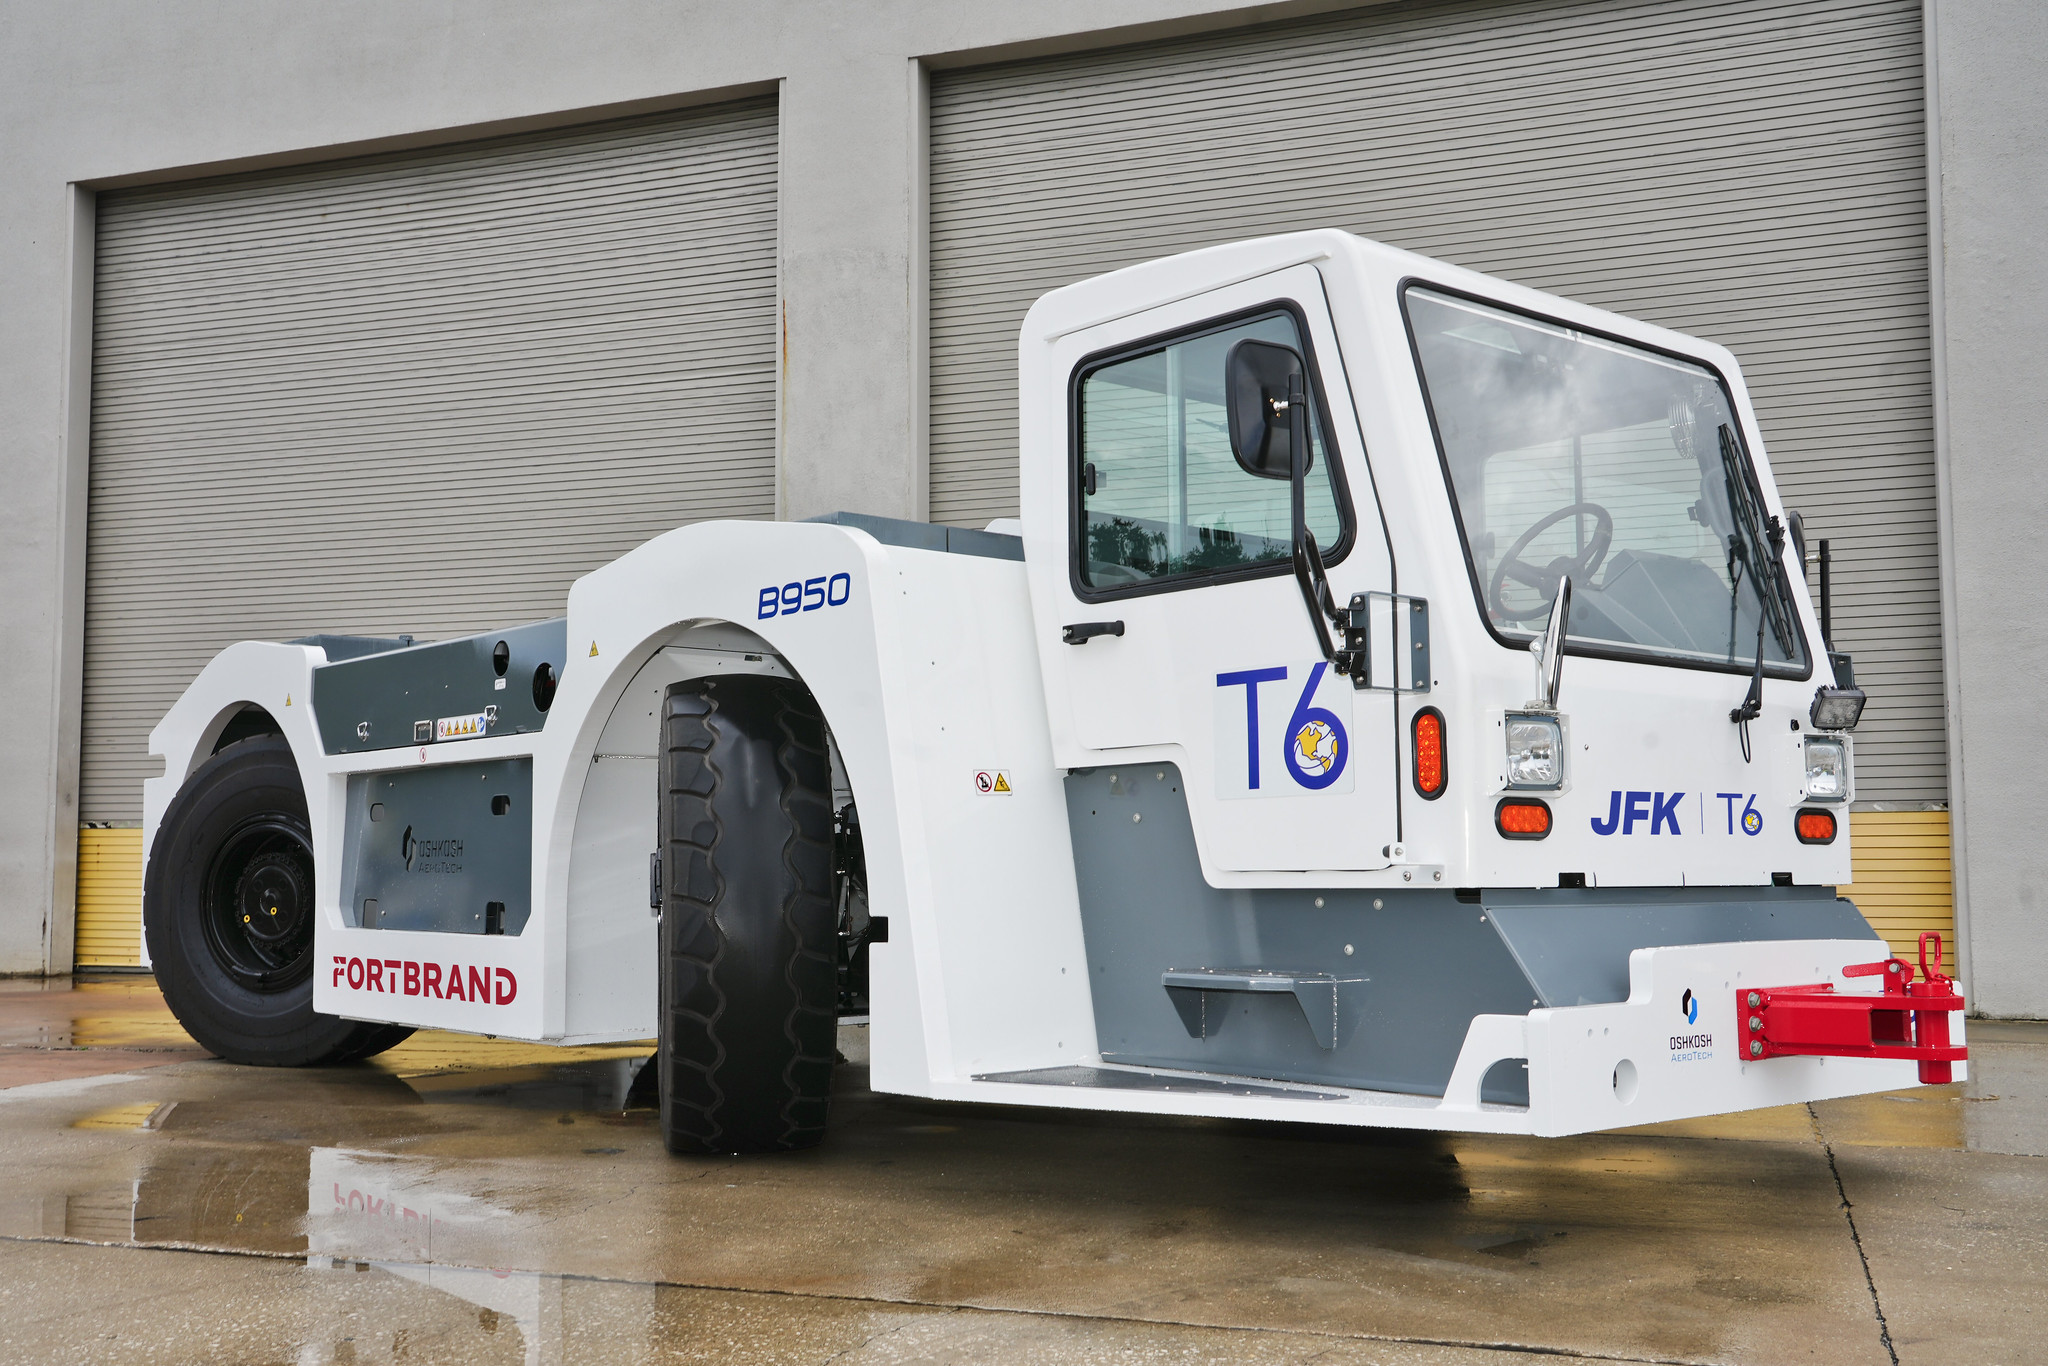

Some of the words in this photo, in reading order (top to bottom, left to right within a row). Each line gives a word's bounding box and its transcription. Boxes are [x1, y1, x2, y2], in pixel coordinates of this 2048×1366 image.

[758, 572, 851, 620] B950
[1216, 661, 1349, 790] T6
[1591, 791, 1686, 836] JFK
[1716, 793, 1763, 836] T6
[419, 840, 463, 857] OSHKOSH
[333, 956, 518, 1006] FORTBRAND
[1670, 1034, 1712, 1050] OSHKOSH
